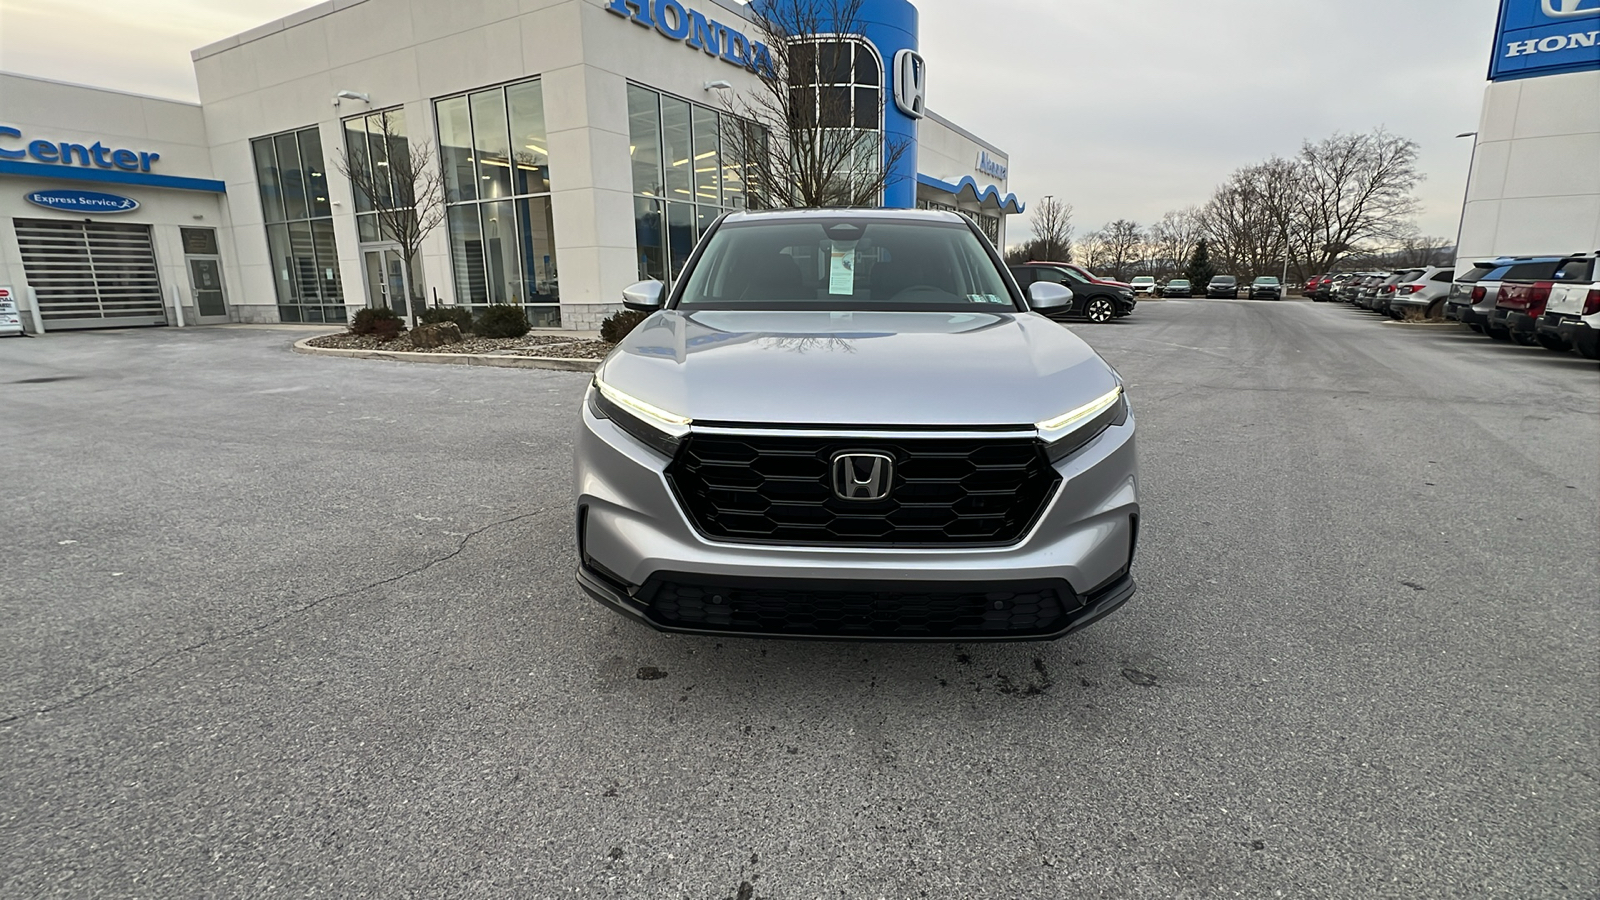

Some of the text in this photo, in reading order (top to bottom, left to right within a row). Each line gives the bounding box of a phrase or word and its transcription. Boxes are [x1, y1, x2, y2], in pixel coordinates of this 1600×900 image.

[1504, 31, 1600, 58] HON
[0, 126, 160, 172] Center
[33, 194, 117, 206] Express Service
